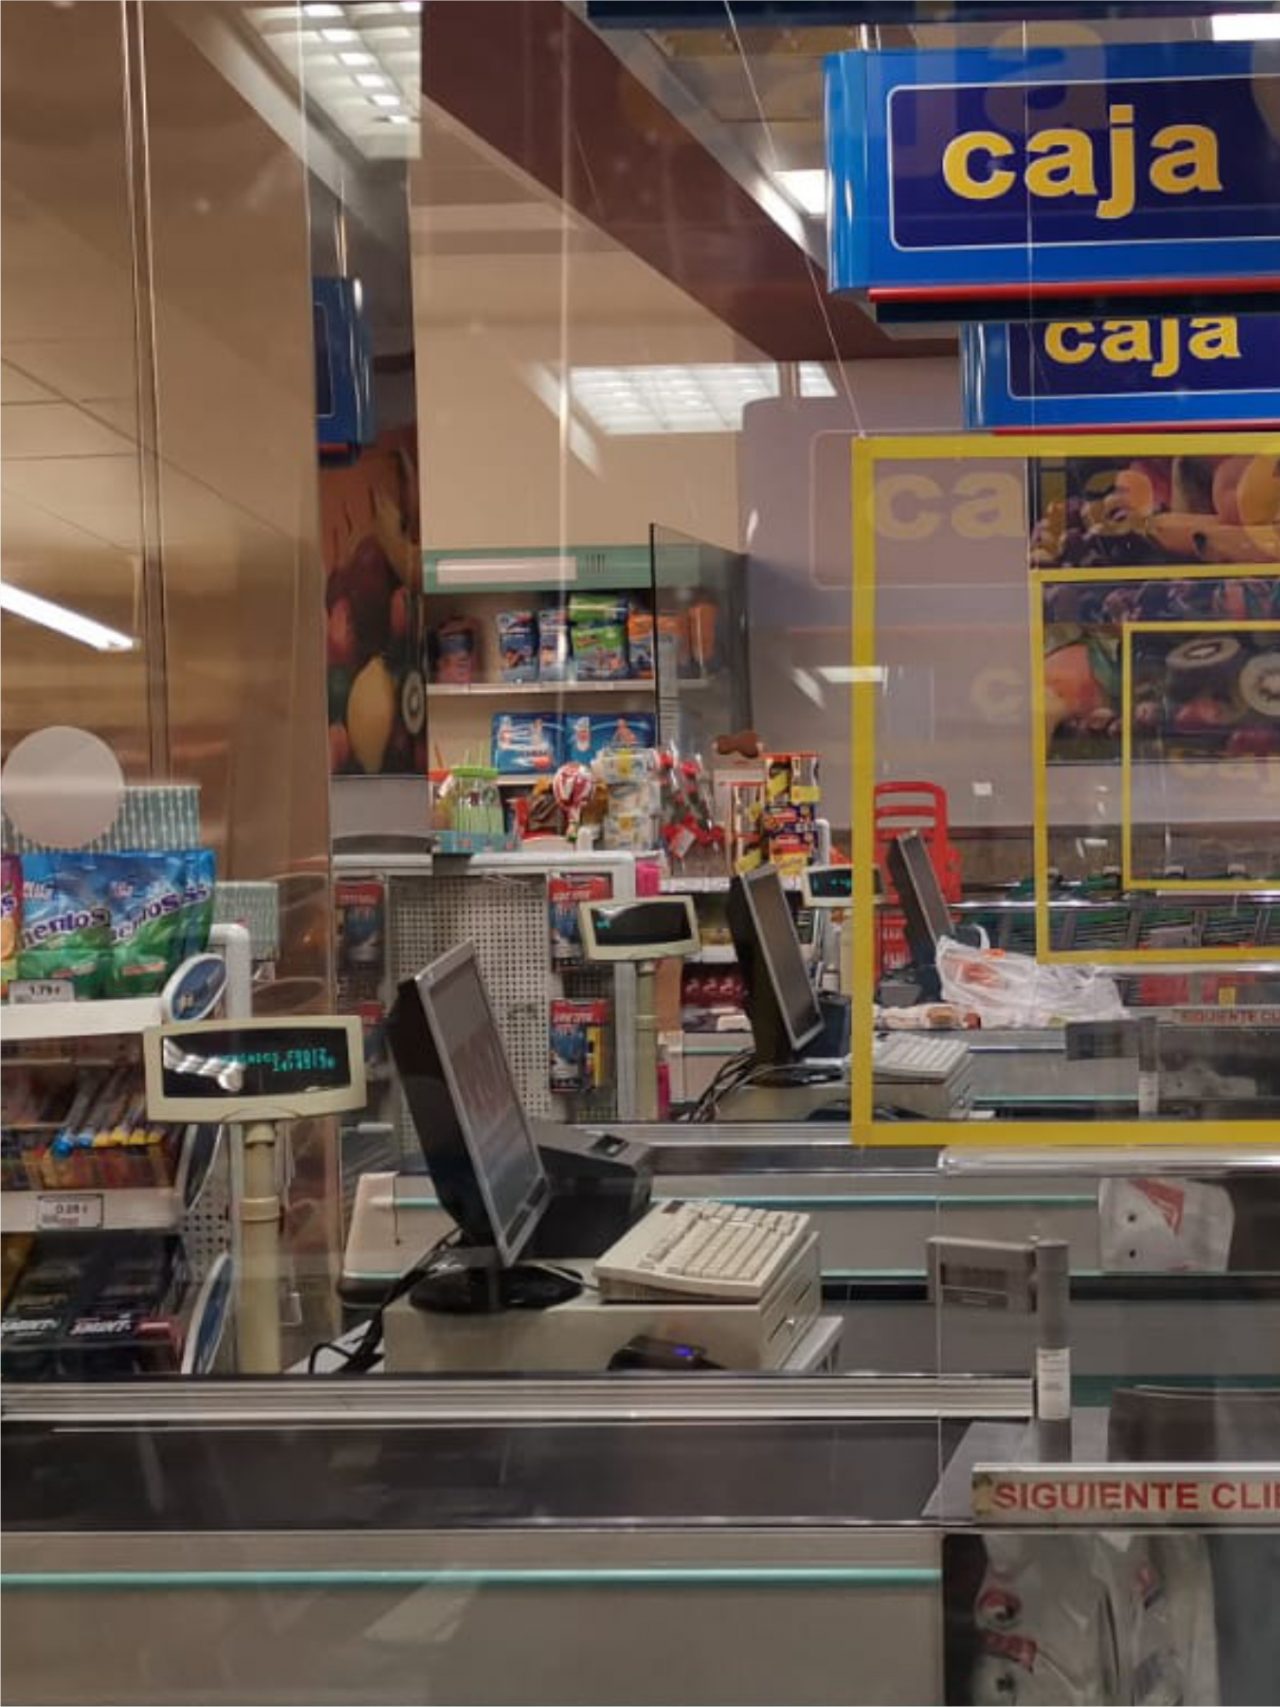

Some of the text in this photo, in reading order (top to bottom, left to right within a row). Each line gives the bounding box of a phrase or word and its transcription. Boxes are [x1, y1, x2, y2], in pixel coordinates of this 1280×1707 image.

[942, 104, 1223, 220] caja
[1044, 313, 1242, 378] caja
[994, 1482, 1198, 1512] SIGUIENTE
